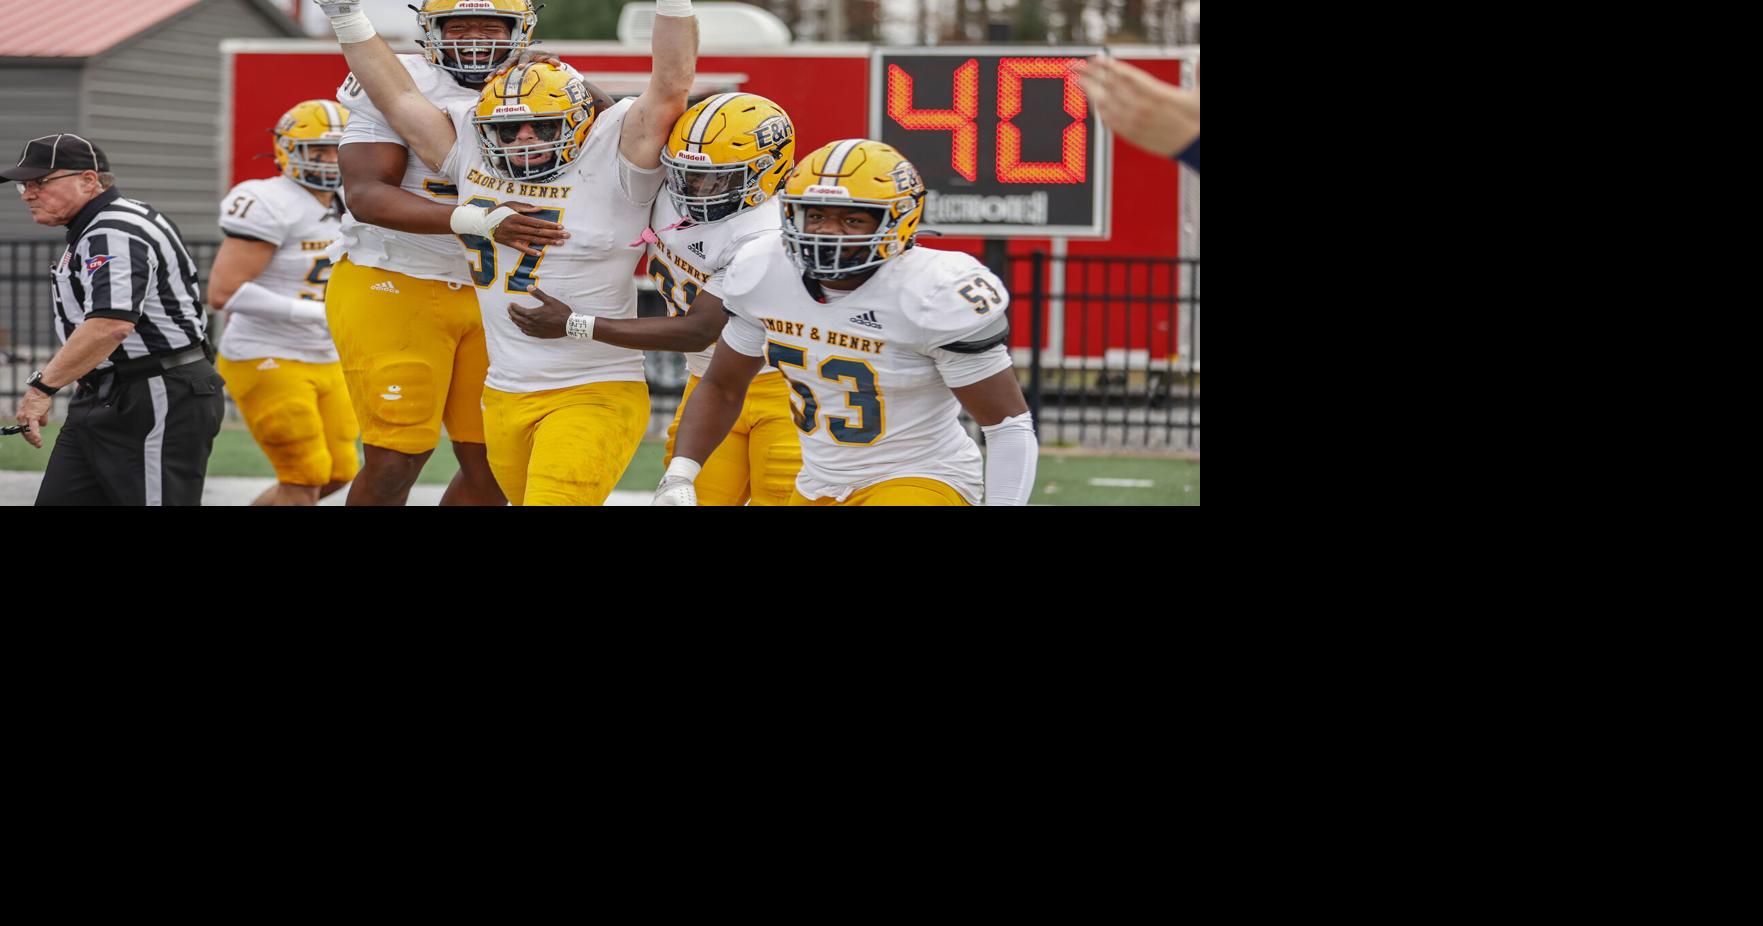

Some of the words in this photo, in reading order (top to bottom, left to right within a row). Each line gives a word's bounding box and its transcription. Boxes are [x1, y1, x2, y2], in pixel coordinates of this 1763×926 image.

[753, 118, 793, 150] E&H
[887, 57, 1087, 184] 40
[678, 152, 706, 161] Riddell
[506, 182, 515, 194] &
[519, 184, 572, 199] HENRY
[228, 196, 255, 219] 51
[674, 254, 711, 283] HENRY
[957, 276, 1003, 315] 53
[849, 317, 883, 330] adidas
[810, 326, 820, 341] &
[827, 330, 885, 354] HENRY
[766, 338, 886, 447] 53
